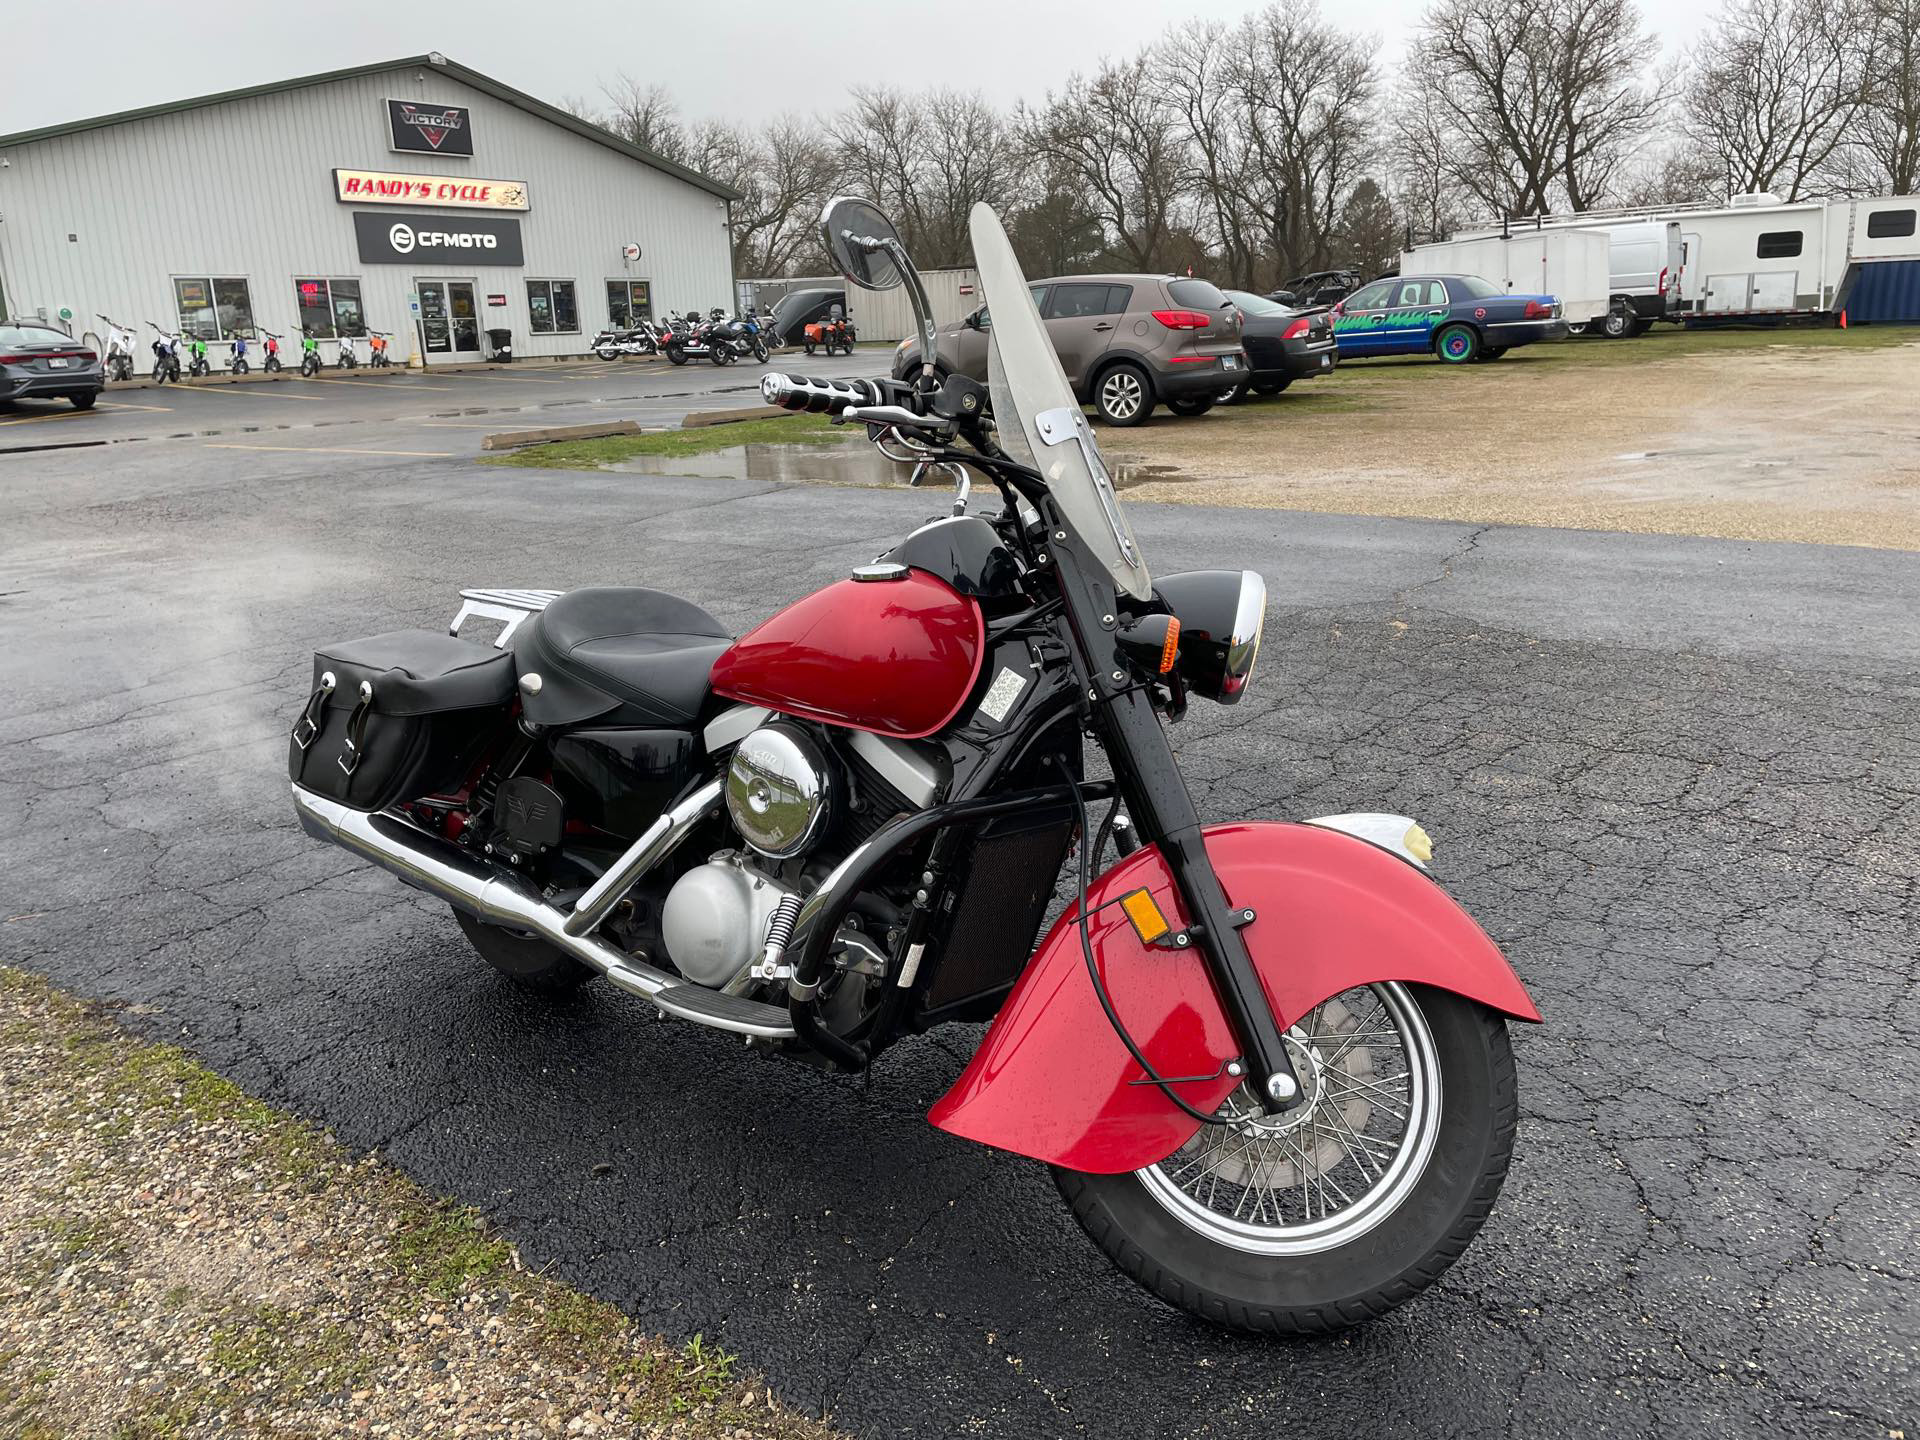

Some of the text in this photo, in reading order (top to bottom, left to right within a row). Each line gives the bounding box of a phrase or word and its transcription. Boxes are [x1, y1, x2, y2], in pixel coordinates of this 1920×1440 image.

[403, 114, 462, 128] VICTORY
[345, 178, 492, 201] RANDY'S CYCLE
[418, 232, 497, 248] CFMOTO
